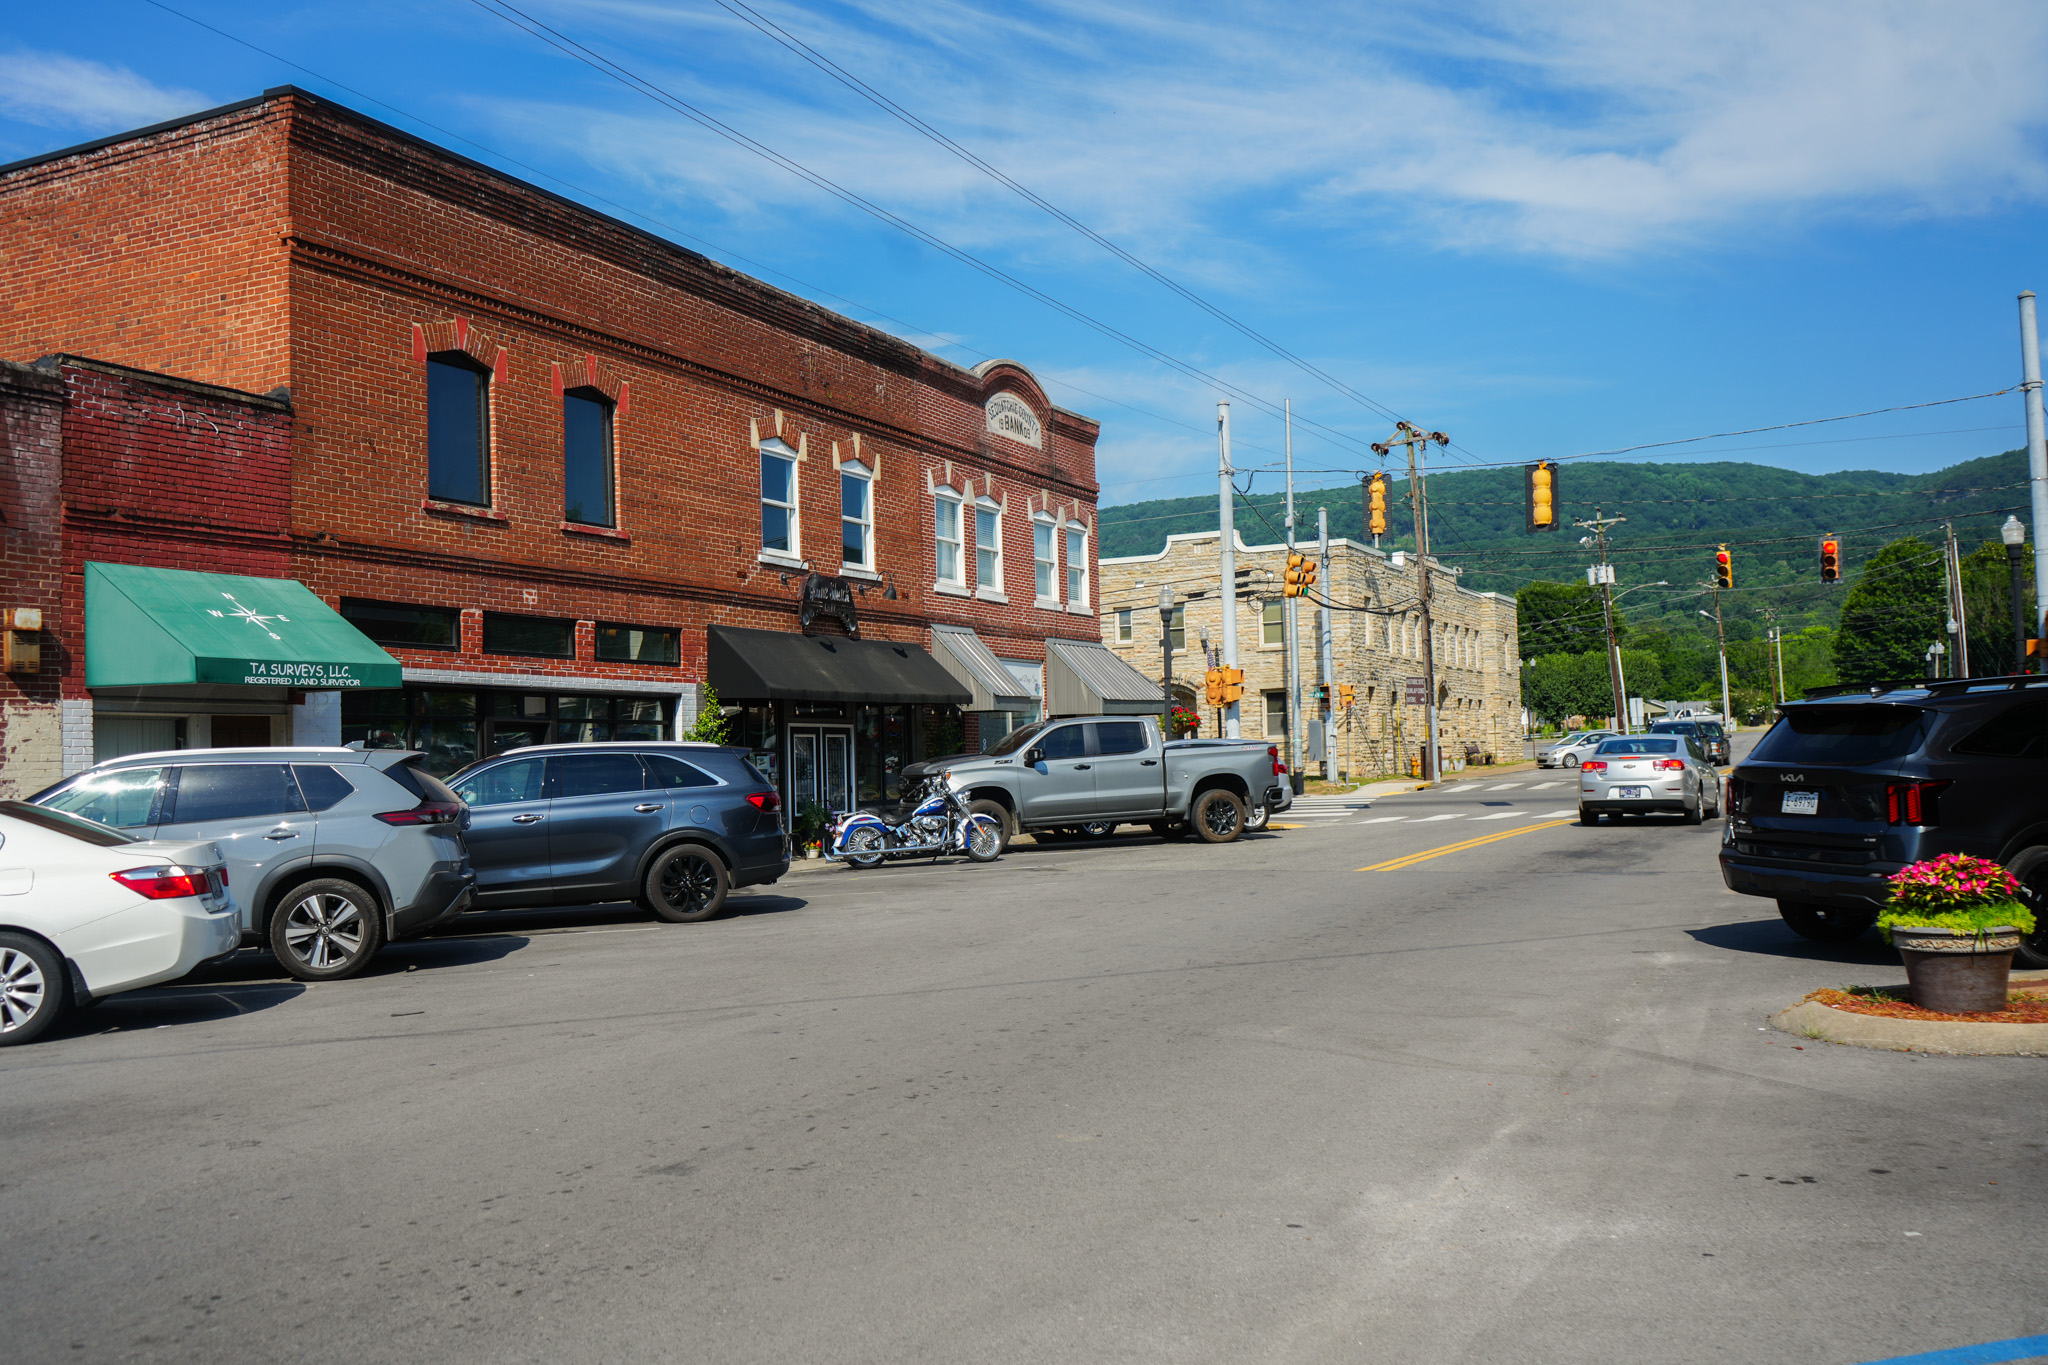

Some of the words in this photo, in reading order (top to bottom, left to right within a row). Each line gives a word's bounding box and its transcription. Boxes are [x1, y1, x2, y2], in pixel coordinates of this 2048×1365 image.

[987, 400, 1018, 420] SEQUATCHIE
[1018, 406, 1039, 436] COUNTY
[1004, 415, 1024, 436] BANK
[249, 662, 267, 675] TA
[270, 663, 327, 678] SURVEYS,
[329, 665, 352, 678] LLC.
[244, 676, 292, 685] REGISTERED
[294, 678, 319, 686] LAND
[320, 678, 361, 687] SURVEYOR
